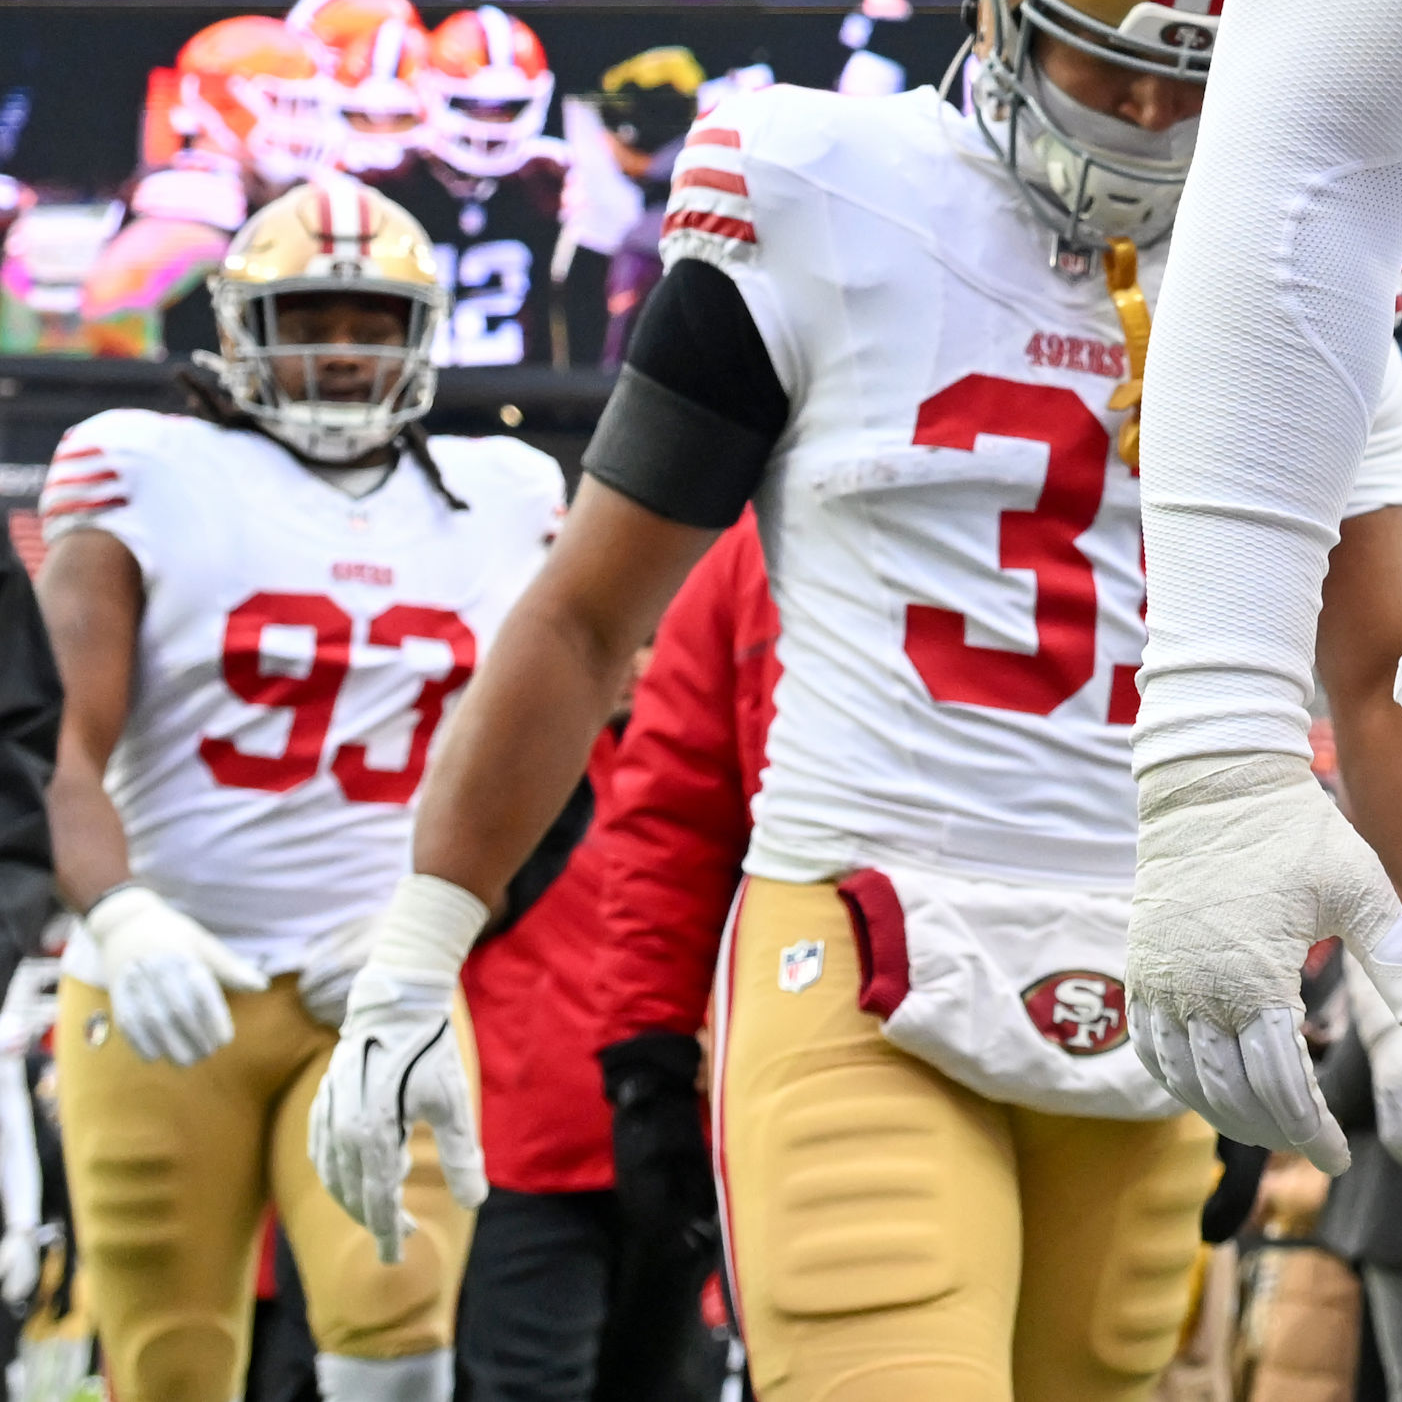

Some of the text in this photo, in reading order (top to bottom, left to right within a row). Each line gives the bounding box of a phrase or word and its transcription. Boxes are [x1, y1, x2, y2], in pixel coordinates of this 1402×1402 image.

[1025, 331, 1126, 379] 49ERS
[905, 373, 1148, 725] 3
[200, 591, 477, 806] 93
[1052, 977, 1120, 1049] SF
